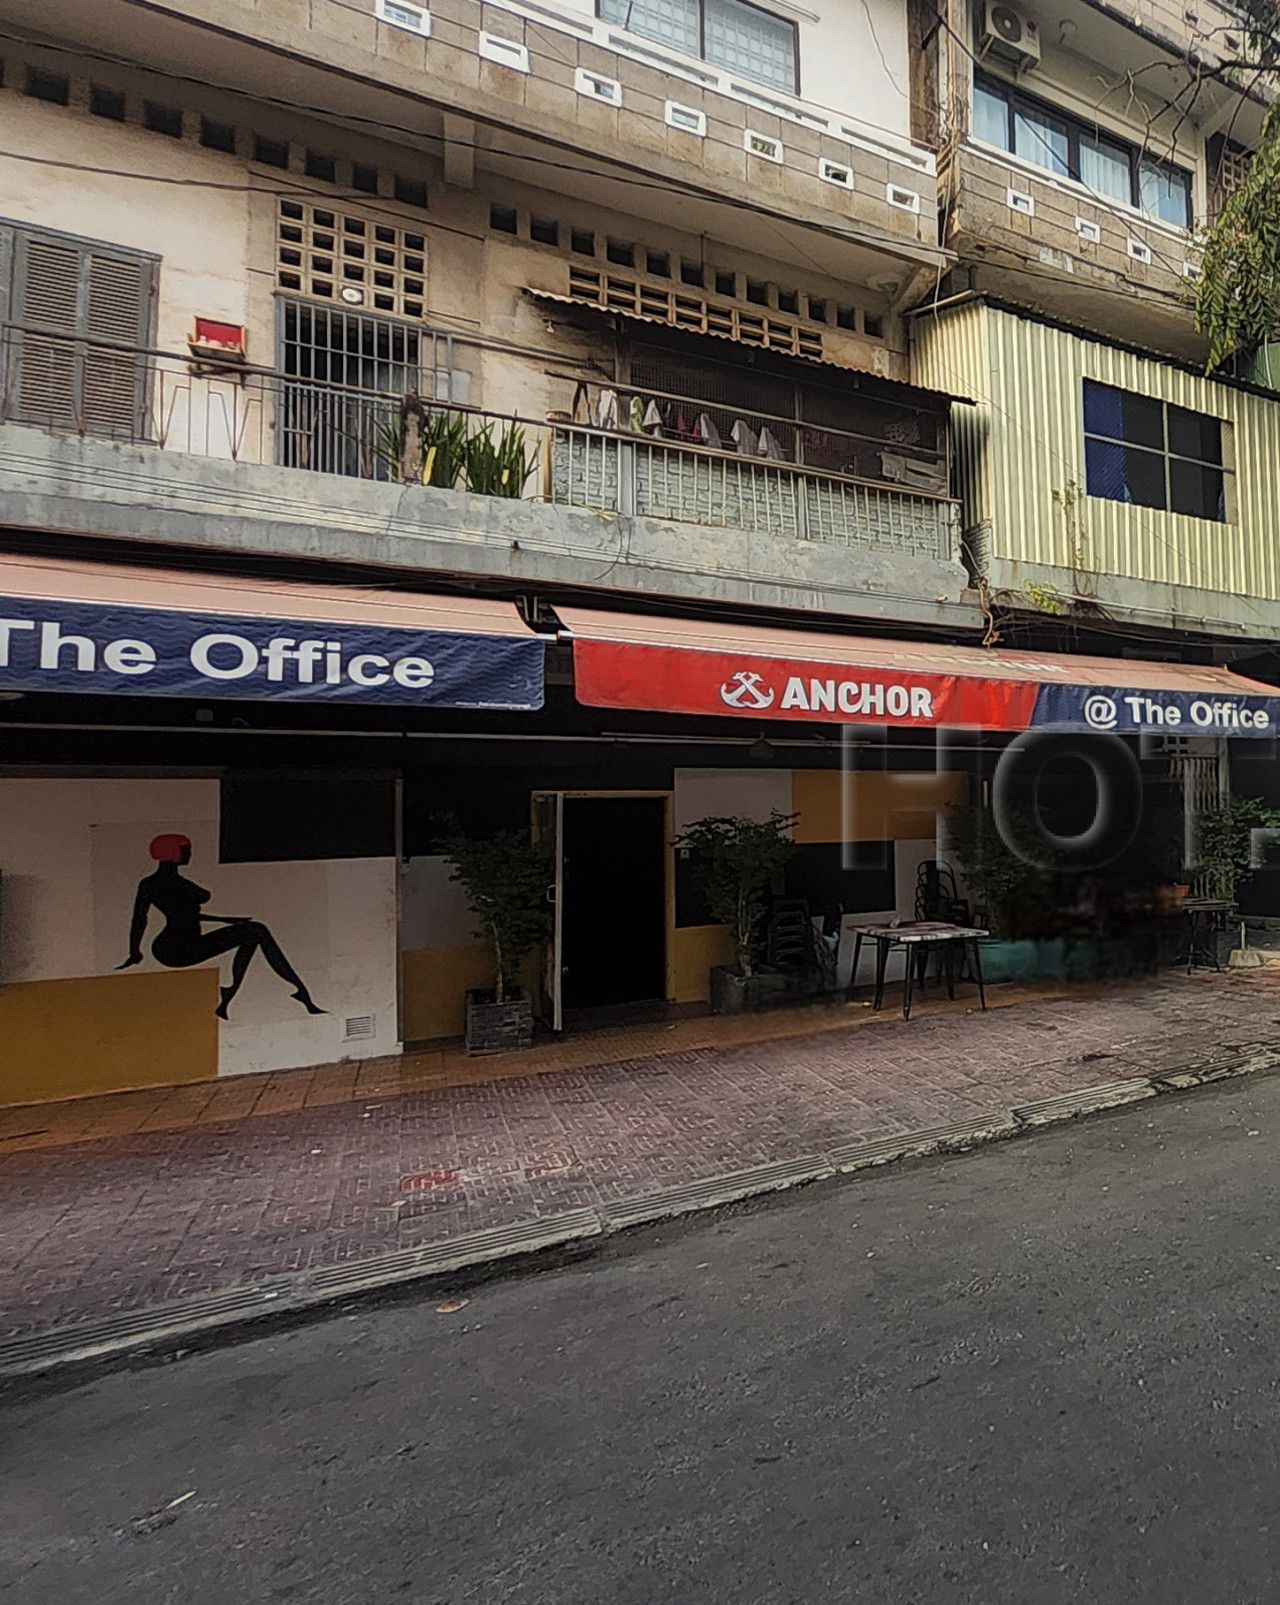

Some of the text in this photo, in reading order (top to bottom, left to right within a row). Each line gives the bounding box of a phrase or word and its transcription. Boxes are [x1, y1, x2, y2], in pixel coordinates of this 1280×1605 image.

[0, 618, 436, 689] The Office
[780, 676, 934, 719] ANCHOR
[1084, 694, 1270, 730] @ The Office
